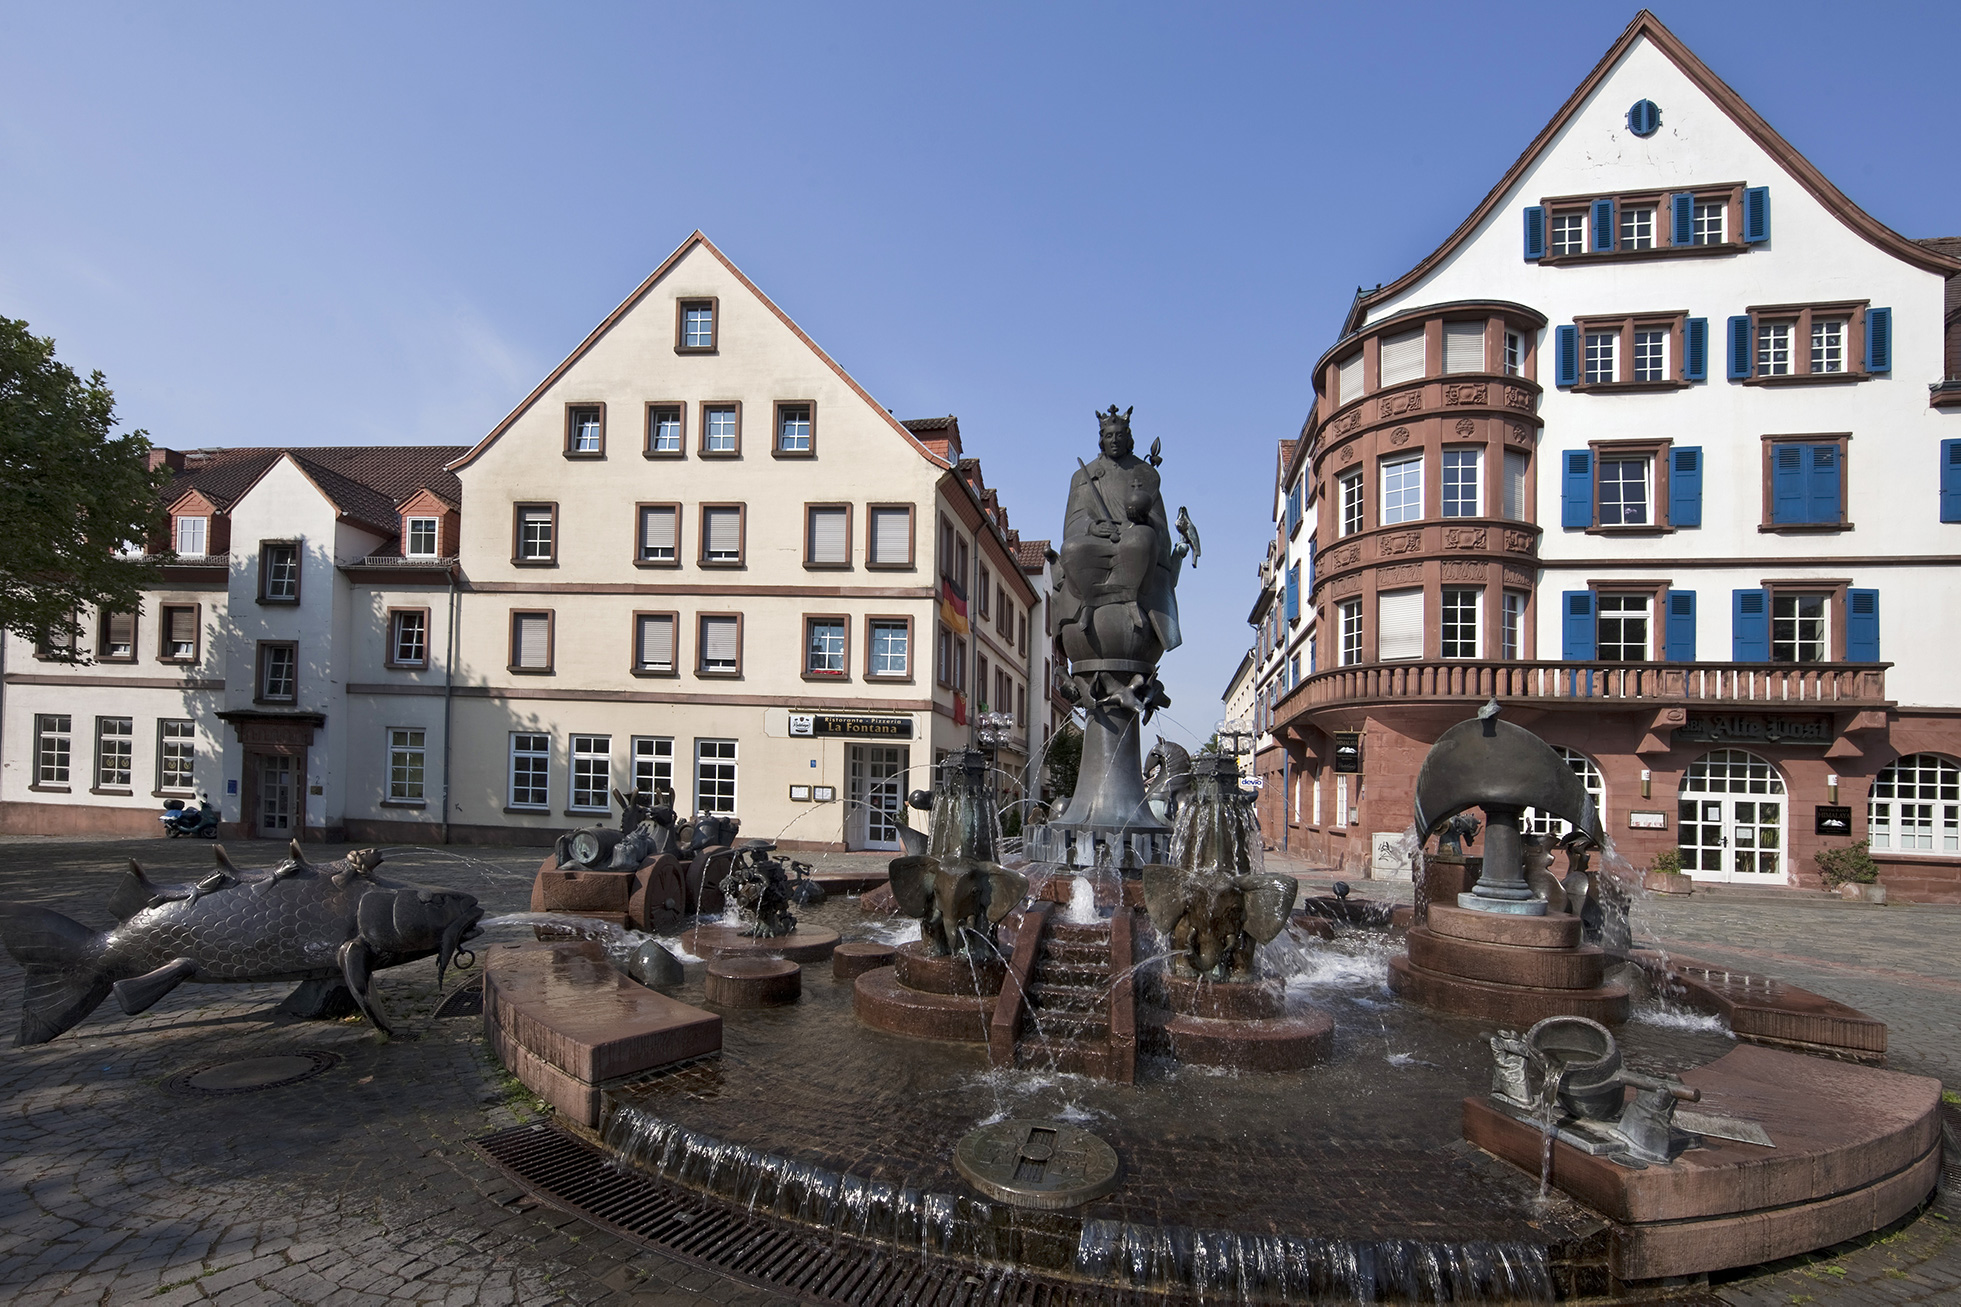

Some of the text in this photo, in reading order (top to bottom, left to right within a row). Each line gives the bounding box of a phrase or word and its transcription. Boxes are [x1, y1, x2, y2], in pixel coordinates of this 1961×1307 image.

[828, 722, 897, 733] La Fontana
[1709, 715, 1829, 741] Alte Post
